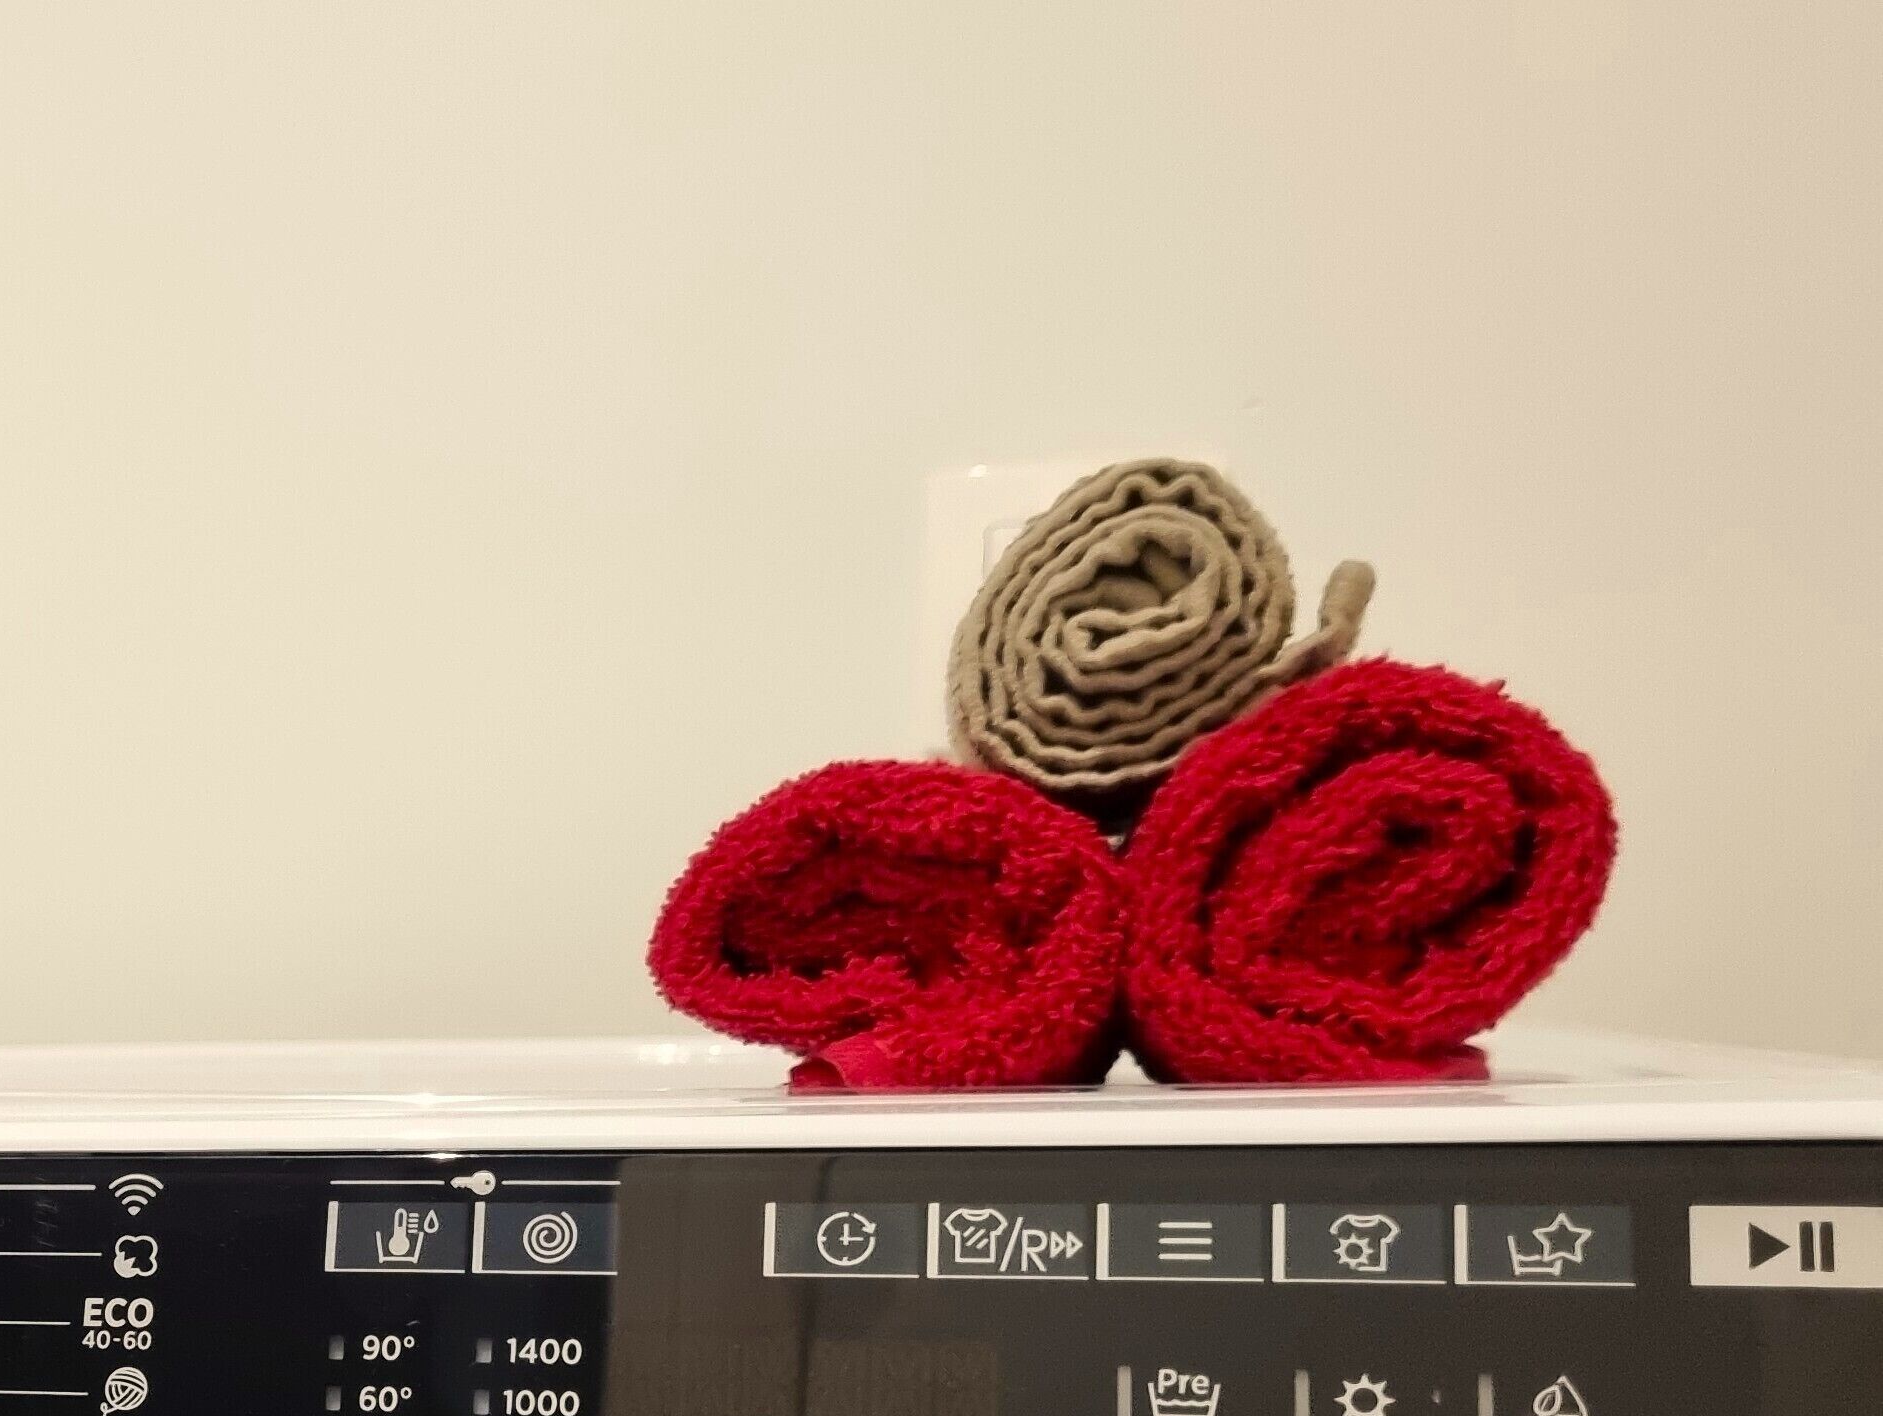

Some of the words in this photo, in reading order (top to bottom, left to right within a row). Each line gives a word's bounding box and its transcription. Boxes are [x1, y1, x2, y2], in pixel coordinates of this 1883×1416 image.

[82, 1297, 154, 1328] ECO
[81, 1330, 152, 1350] 40-60
[362, 1334, 415, 1361] 90°
[506, 1337, 583, 1365] 1400
[1157, 1367, 1211, 1395] Pre
[358, 1385, 413, 1412] 60°
[503, 1389, 581, 1416] 1000
